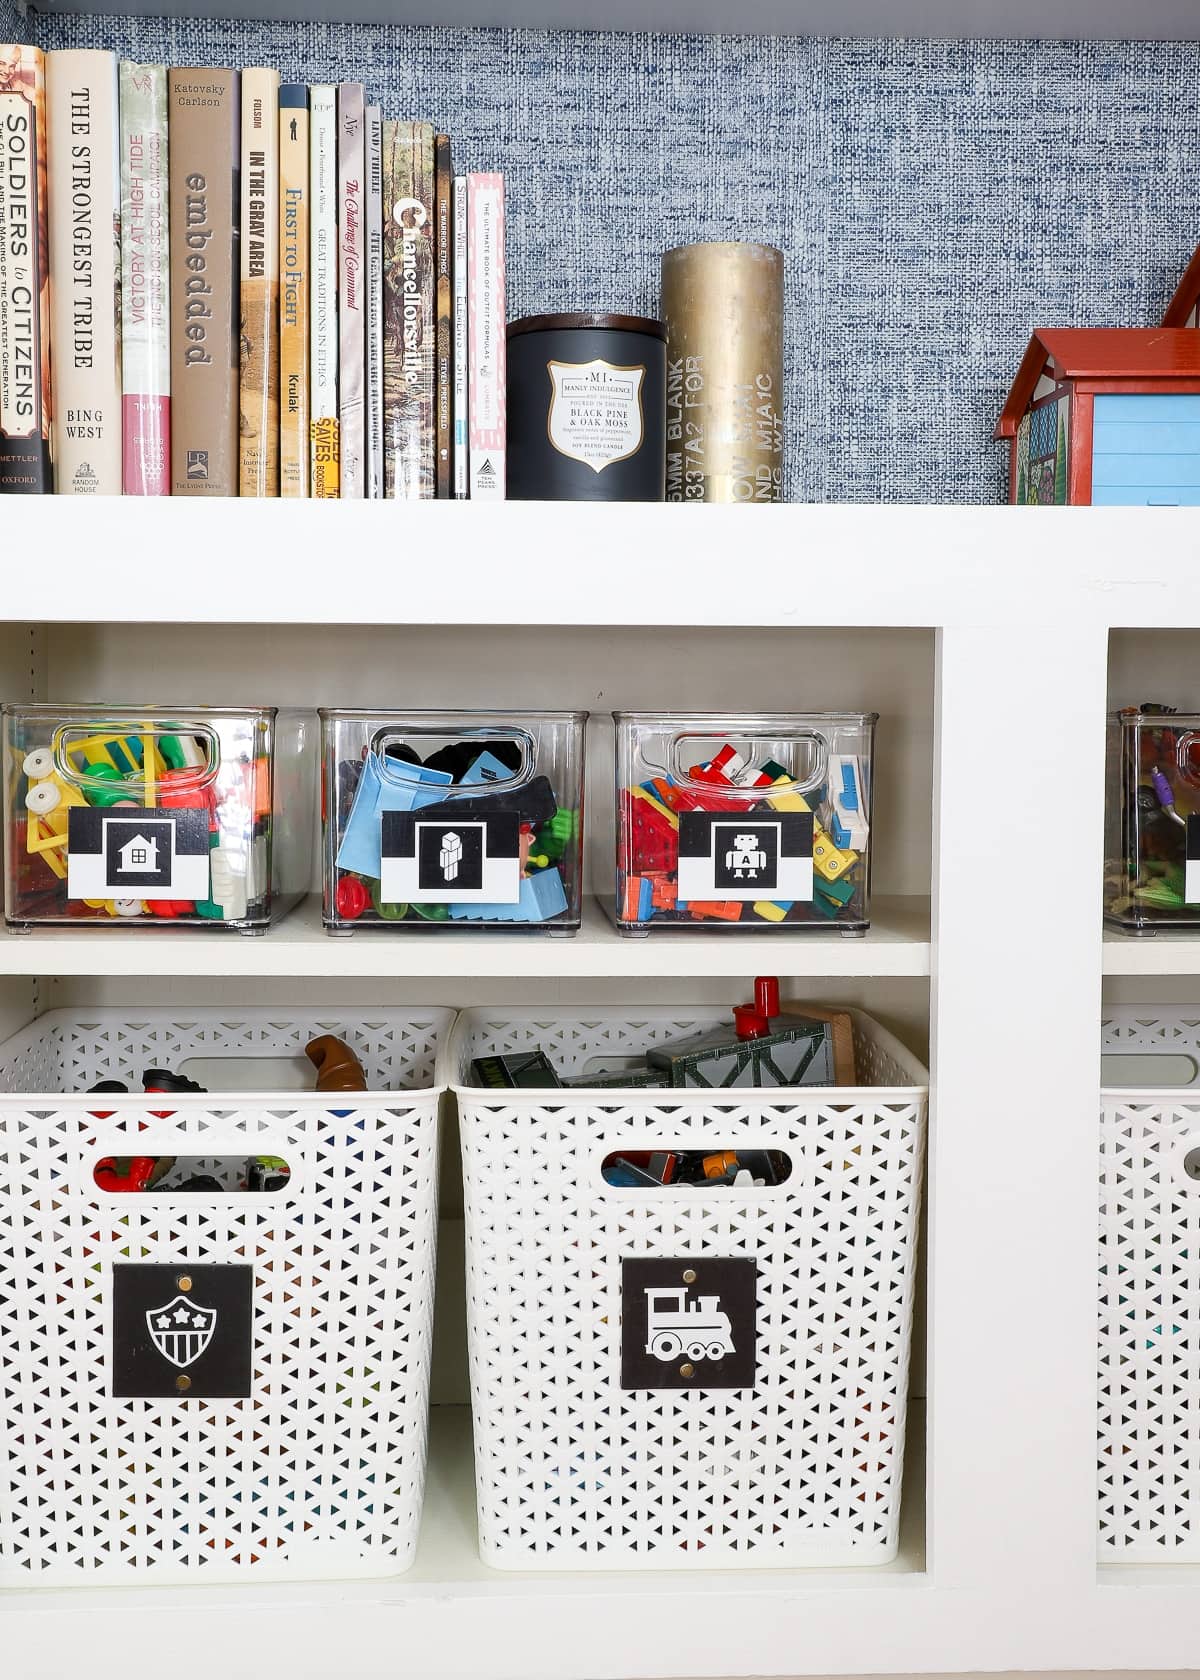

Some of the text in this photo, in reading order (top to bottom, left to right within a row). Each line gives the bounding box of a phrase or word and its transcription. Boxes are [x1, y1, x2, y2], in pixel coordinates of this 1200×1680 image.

[174, 84, 225, 96] Katovsky
[178, 97, 220, 106] Carlson
[254, 98, 262, 128] FOLSOM
[344, 114, 358, 137] Nye
[371, 120, 380, 146] LIND
[371, 155, 380, 194] THIELE
[71, 88, 93, 368] THE STRONGEST TRIBE
[130, 134, 145, 324] VICTORY AT HIGH TIDE
[248, 151, 265, 278] IN THE GRAY AREA
[286, 188, 302, 239] FIRST
[7, 114, 32, 416] SOLDIERS to CITIZENS
[342, 180, 360, 310] The Challenge of Command
[0, 265, 7, 277] OF
[184, 173, 214, 368] embedded
[392, 197, 427, 384] Chancellorsville
[484, 280, 490, 289] OF
[286, 270, 302, 326] FIGHT
[318, 228, 326, 387] GREAT TRADITIONS IN ETHICS
[2, 352, 10, 410] GENERATION
[288, 374, 299, 413] Krulak
[564, 384, 631, 394] MANLY INDULGENCE
[667, 358, 683, 440] BLANK
[66, 410, 104, 422] BING
[66, 426, 104, 439] WEST
[570, 408, 628, 419] BLACK PINE
[605, 420, 628, 428] MOSS
[685, 355, 704, 502] 337A2 FOR
[316, 418, 331, 462] SAVES
[756, 373, 772, 502] ND M1A1C
[2, 476, 37, 484] OXFORD
[732, 456, 754, 502] OW
[742, 856, 750, 864] A
